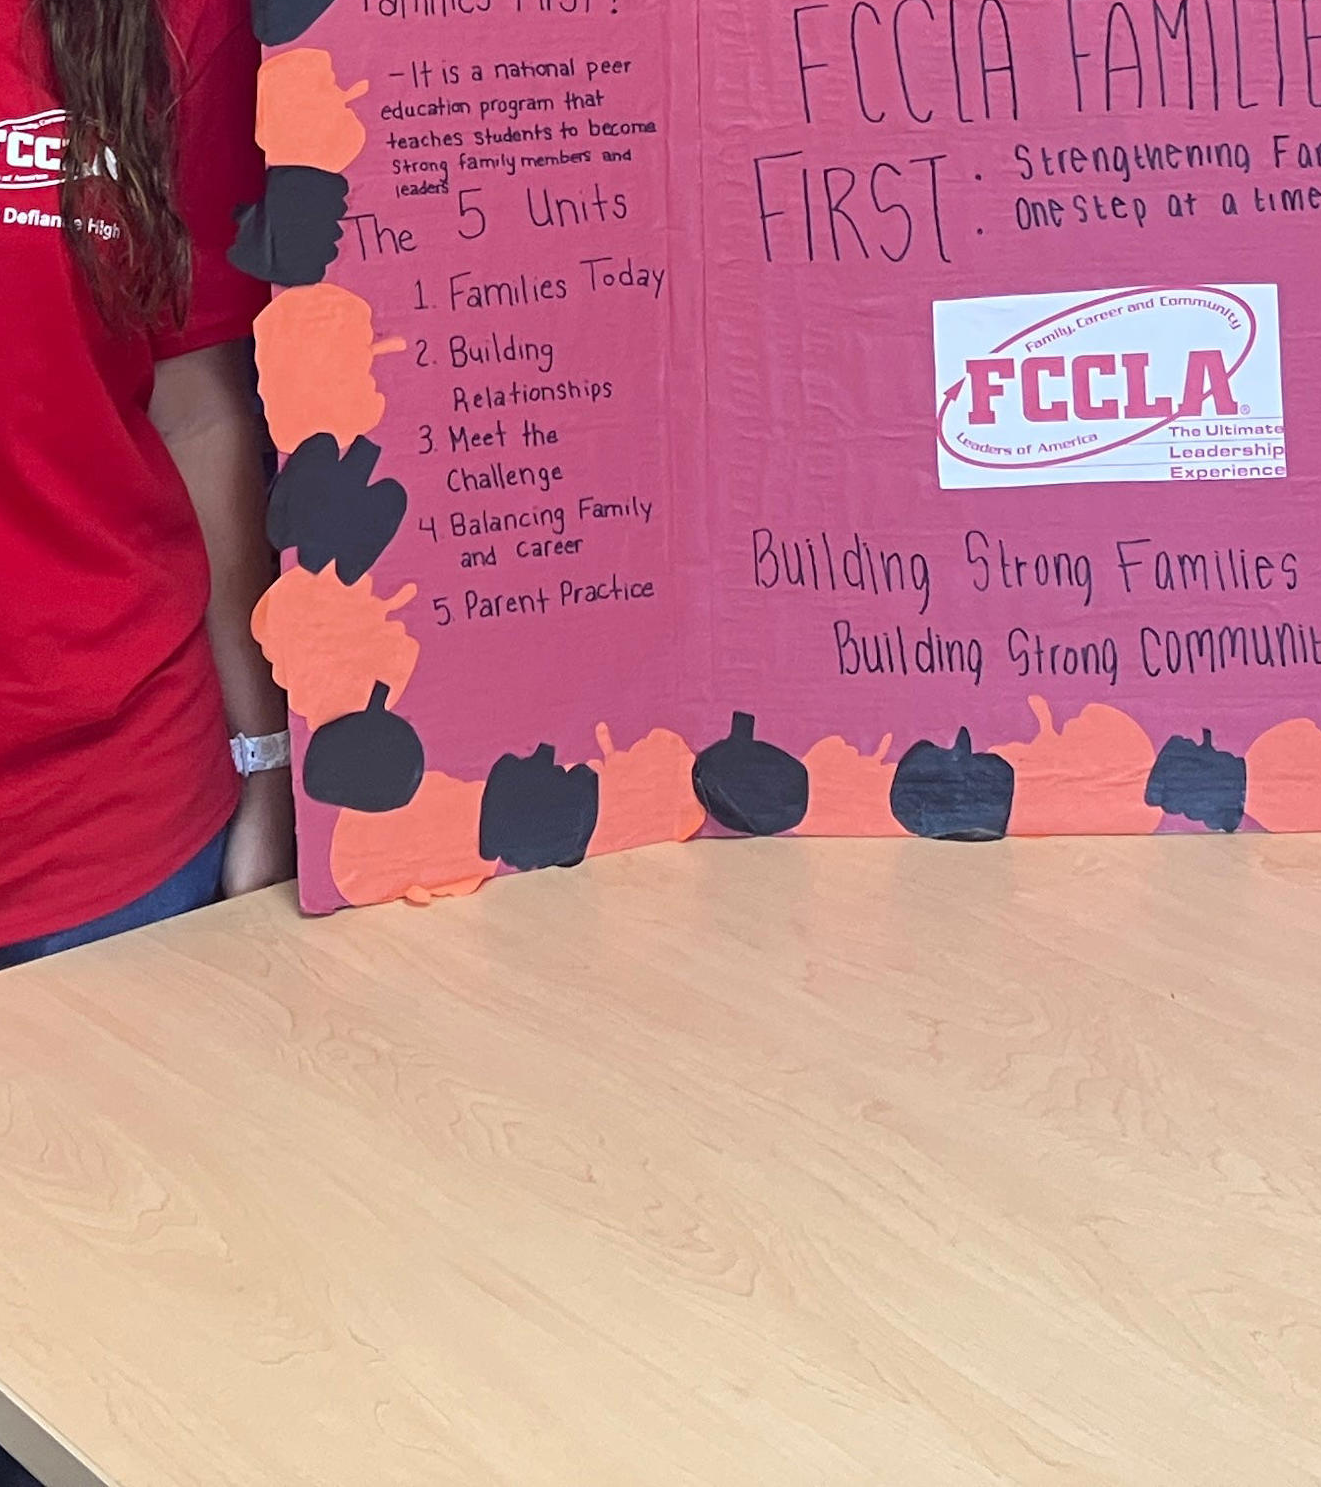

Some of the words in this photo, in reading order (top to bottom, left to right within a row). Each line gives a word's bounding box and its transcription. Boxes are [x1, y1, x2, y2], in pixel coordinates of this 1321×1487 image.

[442, 65, 460, 85] is
[471, 64, 483, 81] a
[494, 58, 576, 80] national
[586, 58, 632, 81] peer
[380, 97, 471, 121] education
[480, 97, 554, 120] program
[564, 89, 604, 110] that
[386, 130, 463, 150] teaches
[560, 121, 578, 138] to
[589, 118, 657, 138] become
[459, 153, 516, 176] family
[521, 150, 591, 169] members
[602, 149, 632, 162] and
[1014, 142, 1251, 182] Strengthening
[396, 179, 449, 199] leaders
[1167, 191, 1197, 217] at
[1222, 191, 1239, 215] a
[3, 206, 82, 231] Defiane
[87, 217, 121, 240] High
[338, 214, 418, 261] The
[457, 187, 487, 240] 5
[526, 183, 628, 227] Units
[449, 271, 567, 311] Families
[580, 257, 666, 299] Today
[1075, 306, 1124, 330] Career
[1127, 298, 1155, 314] and
[1159, 295, 1242, 331] Community
[449, 332, 554, 373] Building
[453, 379, 613, 412] Relationships
[965, 349, 1239, 425] FCCLA
[448, 420, 506, 452] Meet
[521, 419, 559, 446] the
[956, 430, 1013, 457] Leaders
[1016, 444, 1032, 456] of
[1037, 431, 1099, 455] America
[1168, 425, 1201, 439] The
[1205, 423, 1285, 437] Ultimate
[1169, 442, 1285, 461] Leadership
[446, 462, 564, 493] Challenge
[1169, 464, 1286, 480] Experience
[450, 506, 565, 538] Balancing
[578, 496, 653, 523] Family
[461, 546, 497, 568] and
[752, 528, 932, 614] Building
[964, 530, 1094, 606] Strong
[1115, 537, 1298, 593] Families
[465, 589, 551, 619] Parent
[560, 574, 655, 606] Practice
[834, 619, 984, 685] Building
[1008, 626, 1119, 686] Strong
